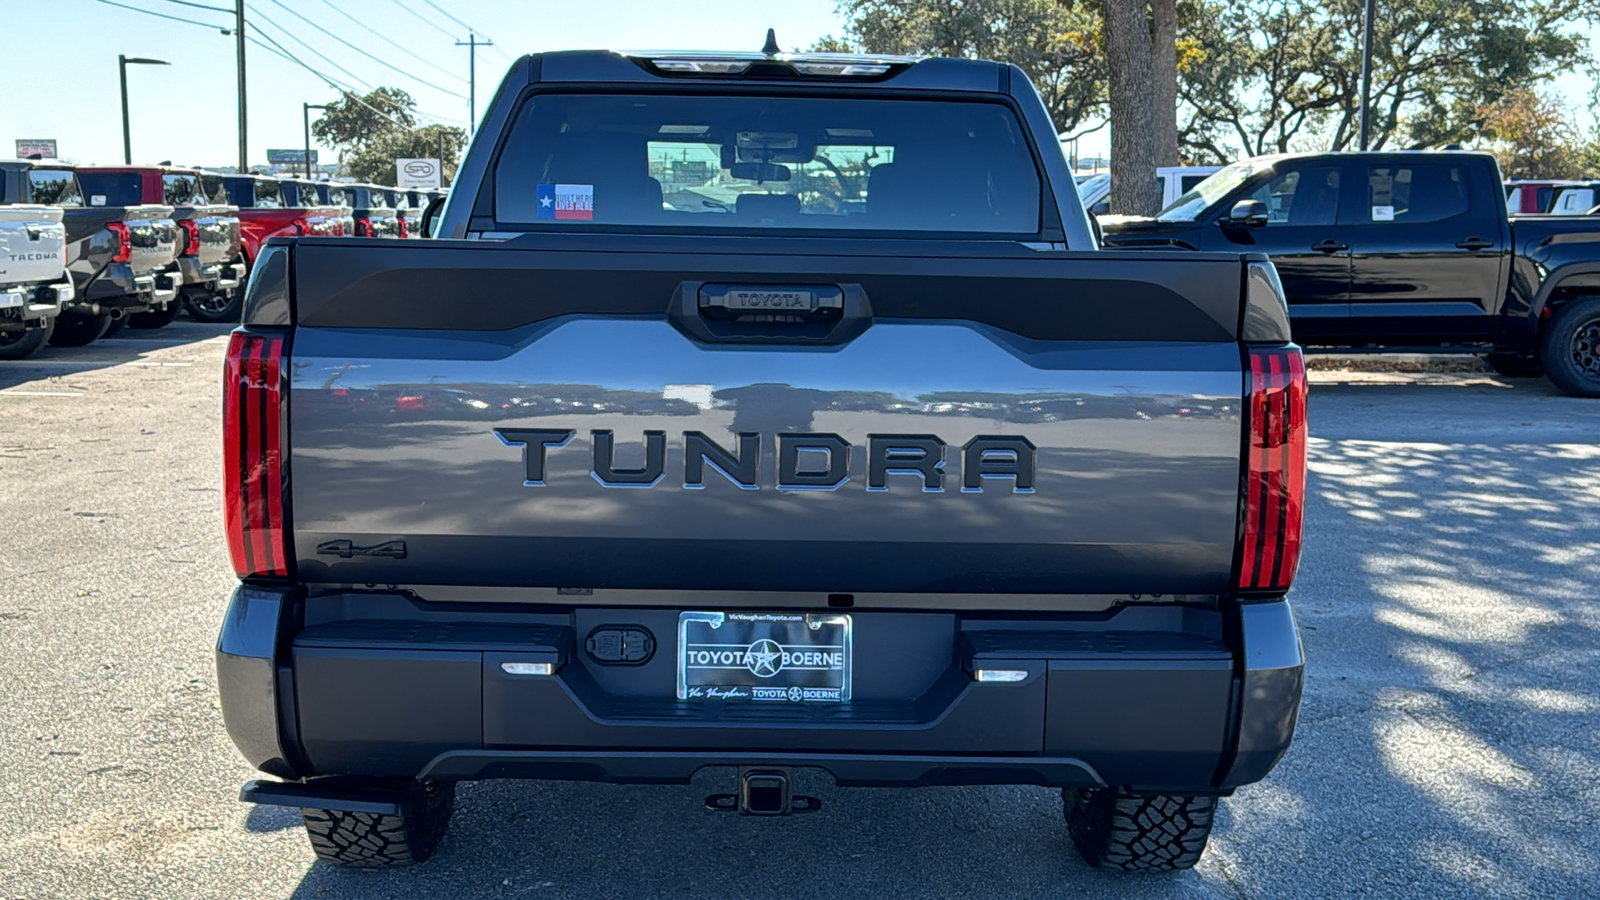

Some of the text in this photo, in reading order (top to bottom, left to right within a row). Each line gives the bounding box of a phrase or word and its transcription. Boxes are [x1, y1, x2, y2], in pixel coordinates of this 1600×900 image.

[555, 194, 593, 203] BUILT HERE
[555, 202, 593, 211] LIVES HERE
[9, 252, 58, 262] TACOMA
[738, 293, 803, 307] TOYOTA
[493, 427, 1037, 494] TUNDRA
[728, 613, 803, 622] VicVaughanToyota.com
[687, 651, 754, 665] TOYOTA
[782, 652, 843, 666] BOERNE
[706, 687, 750, 700] Vaughan
[752, 690, 788, 698] TOYOTA
[803, 691, 841, 699] BOERNE
